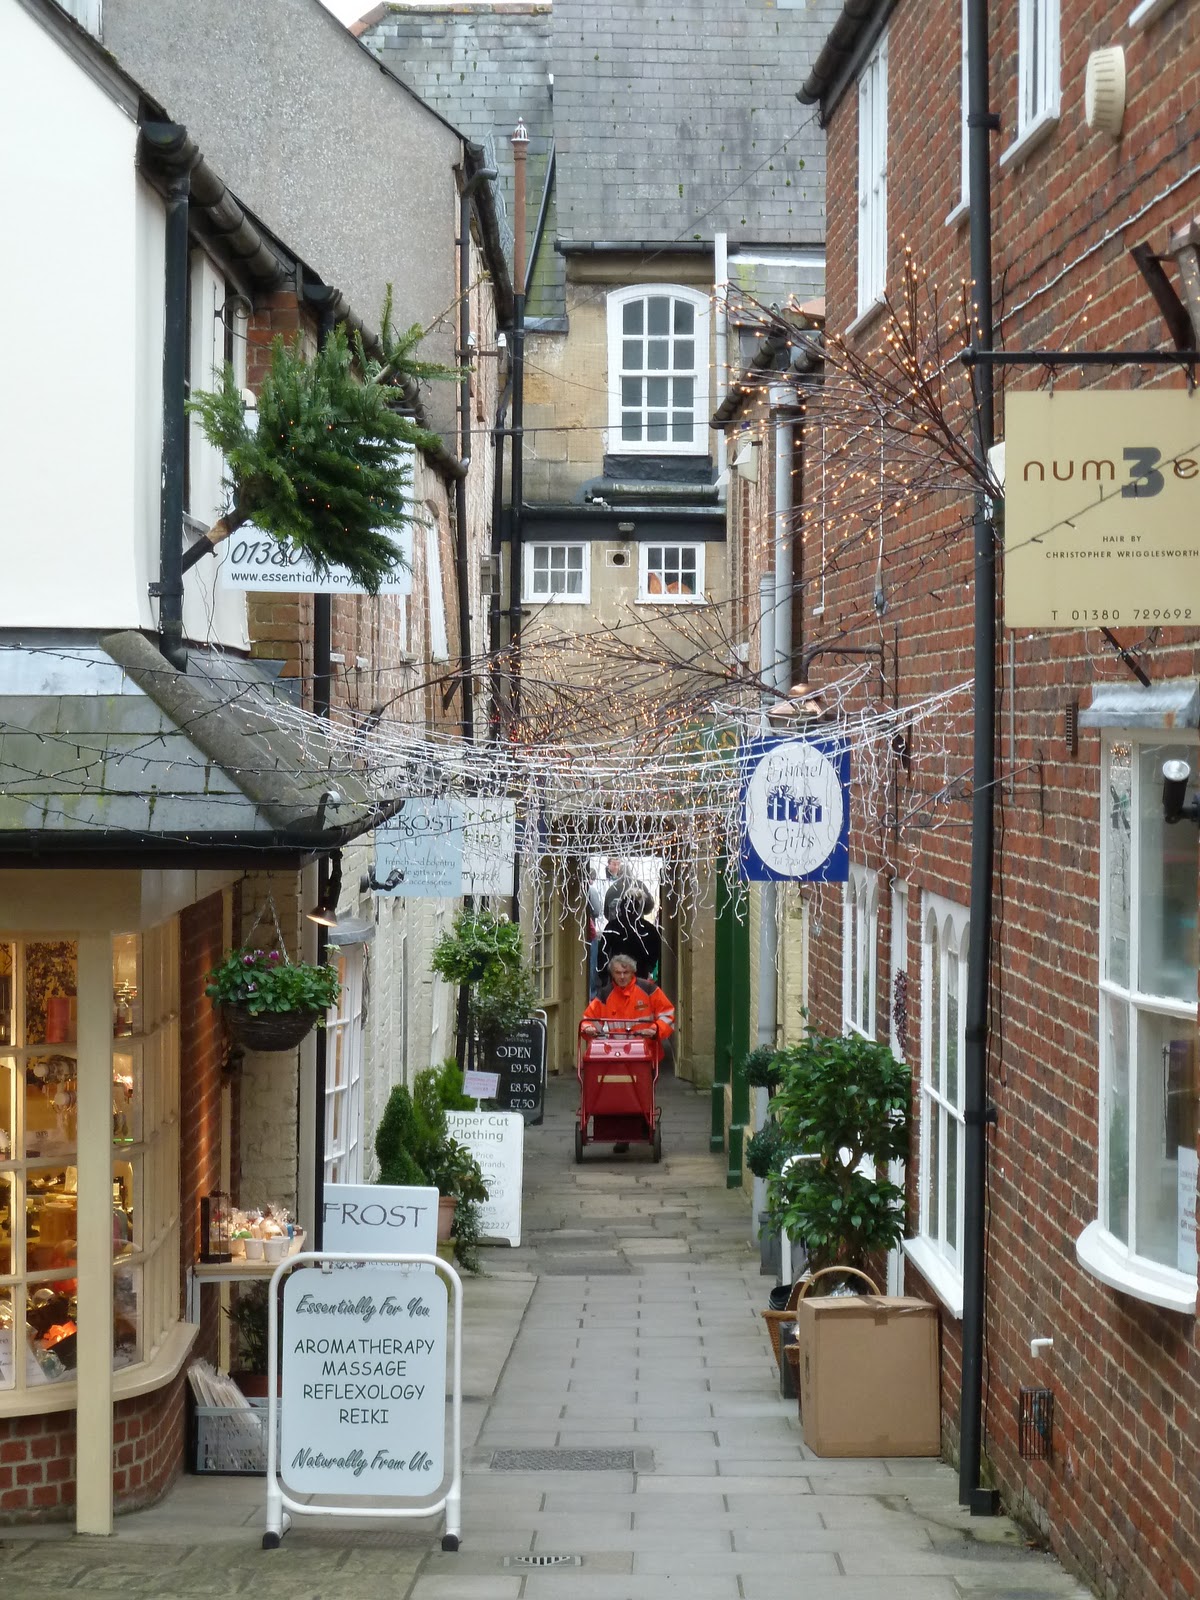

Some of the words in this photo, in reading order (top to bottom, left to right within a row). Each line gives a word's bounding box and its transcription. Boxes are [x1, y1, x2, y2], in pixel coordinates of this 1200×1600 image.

[1102, 535, 1125, 543] HAIR
[1131, 535, 1142, 543] BY
[1046, 551, 1112, 559] CHRISTOPHER
[1117, 550, 1199, 558] WRIGGLESWORTH
[1051, 610, 1059, 621] T
[1071, 609, 1120, 621] 01380
[1133, 608, 1192, 620] 729692
[771, 825, 815, 854] Gifts
[496, 1046, 531, 1059] OPEN
[511, 1064, 537, 1074] £9.50
[510, 1083, 536, 1093] £8.50
[510, 1099, 535, 1109] £7.50
[447, 1115, 484, 1127] Upper
[488, 1116, 509, 1127] Cut
[452, 1129, 504, 1142] Clothing
[322, 1202, 428, 1228] FROST
[296, 1293, 377, 1323] Essentially
[378, 1295, 403, 1316] For
[406, 1296, 430, 1318] You
[293, 1338, 435, 1355] AROMATHERAPY
[321, 1360, 407, 1377] MASSAGE
[303, 1383, 425, 1400] REFLEXOLOGY
[339, 1408, 389, 1425] REIKI
[291, 1447, 369, 1477] Naturally
[370, 1449, 406, 1471] From
[408, 1450, 434, 1472] Us
